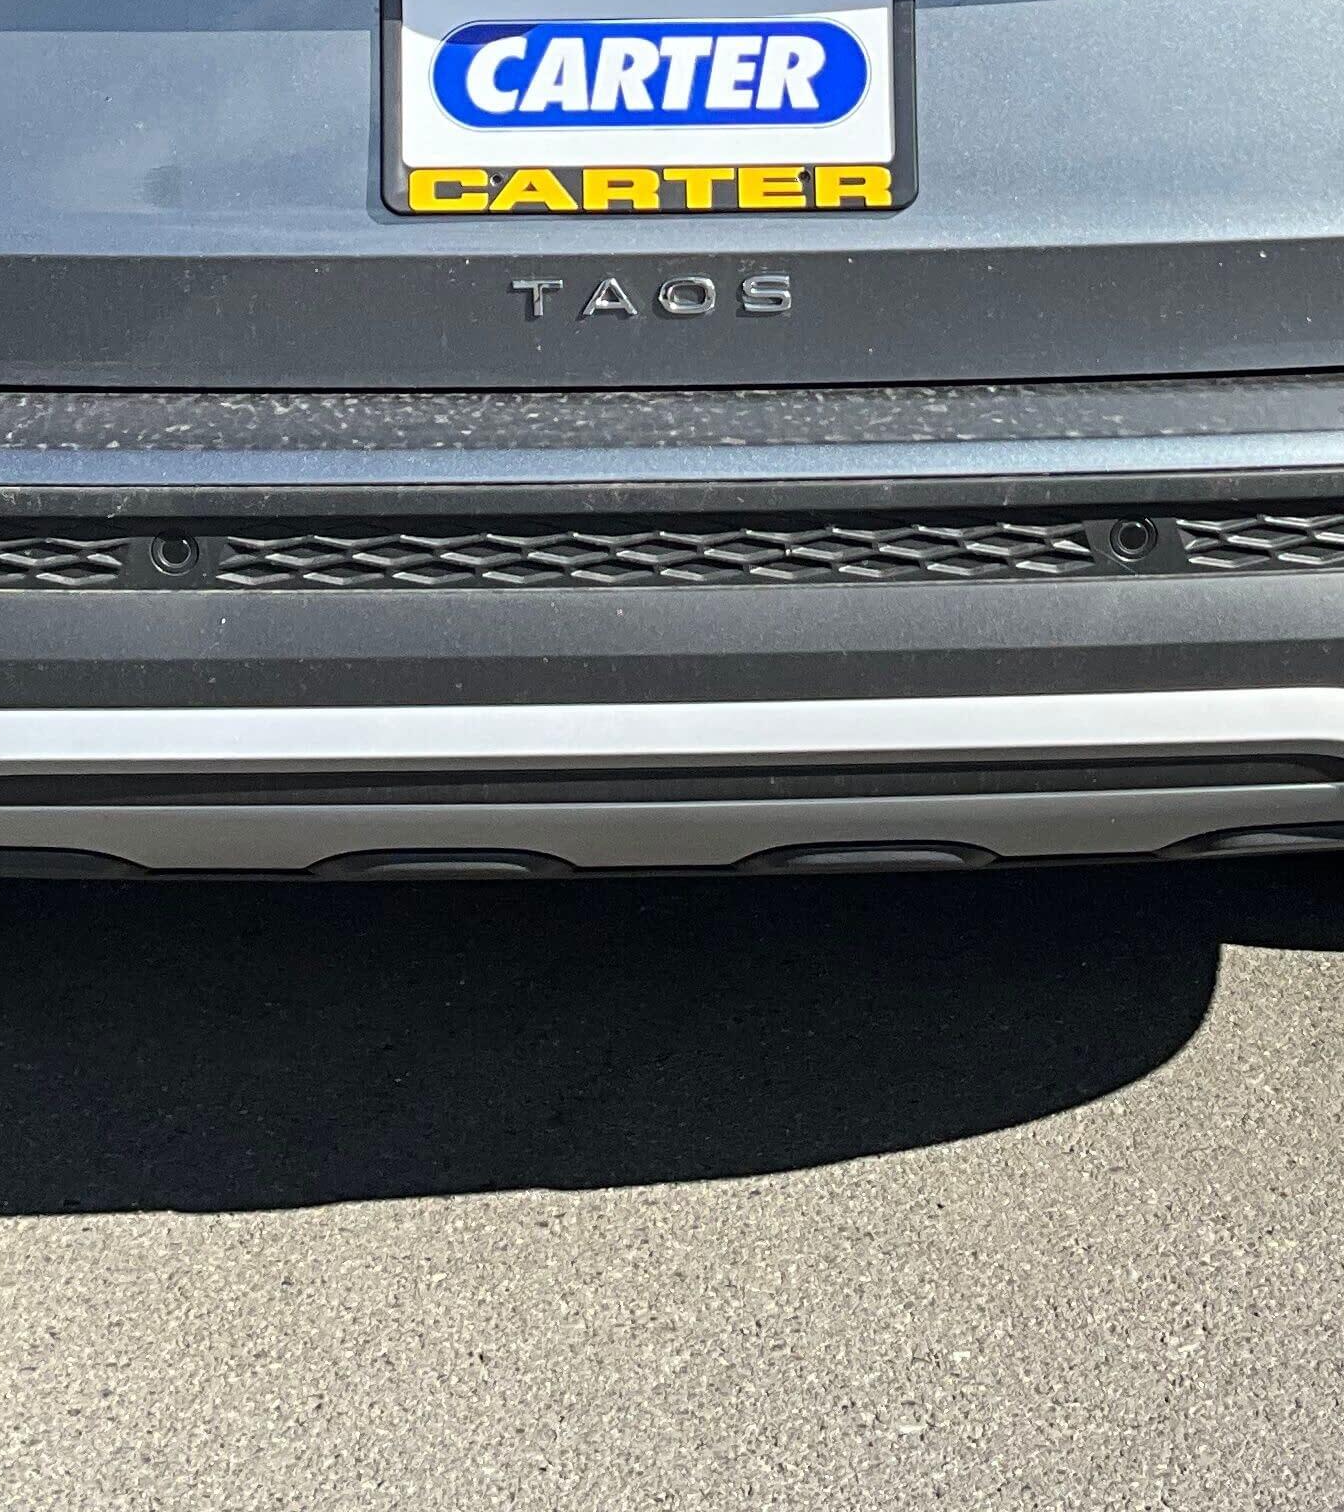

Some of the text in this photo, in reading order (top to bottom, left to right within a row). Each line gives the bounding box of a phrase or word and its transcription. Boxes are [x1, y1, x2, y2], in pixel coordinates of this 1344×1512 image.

[465, 34, 827, 114] CARTER
[408, 165, 893, 212] CARTER
[511, 275, 793, 318] TAOS
